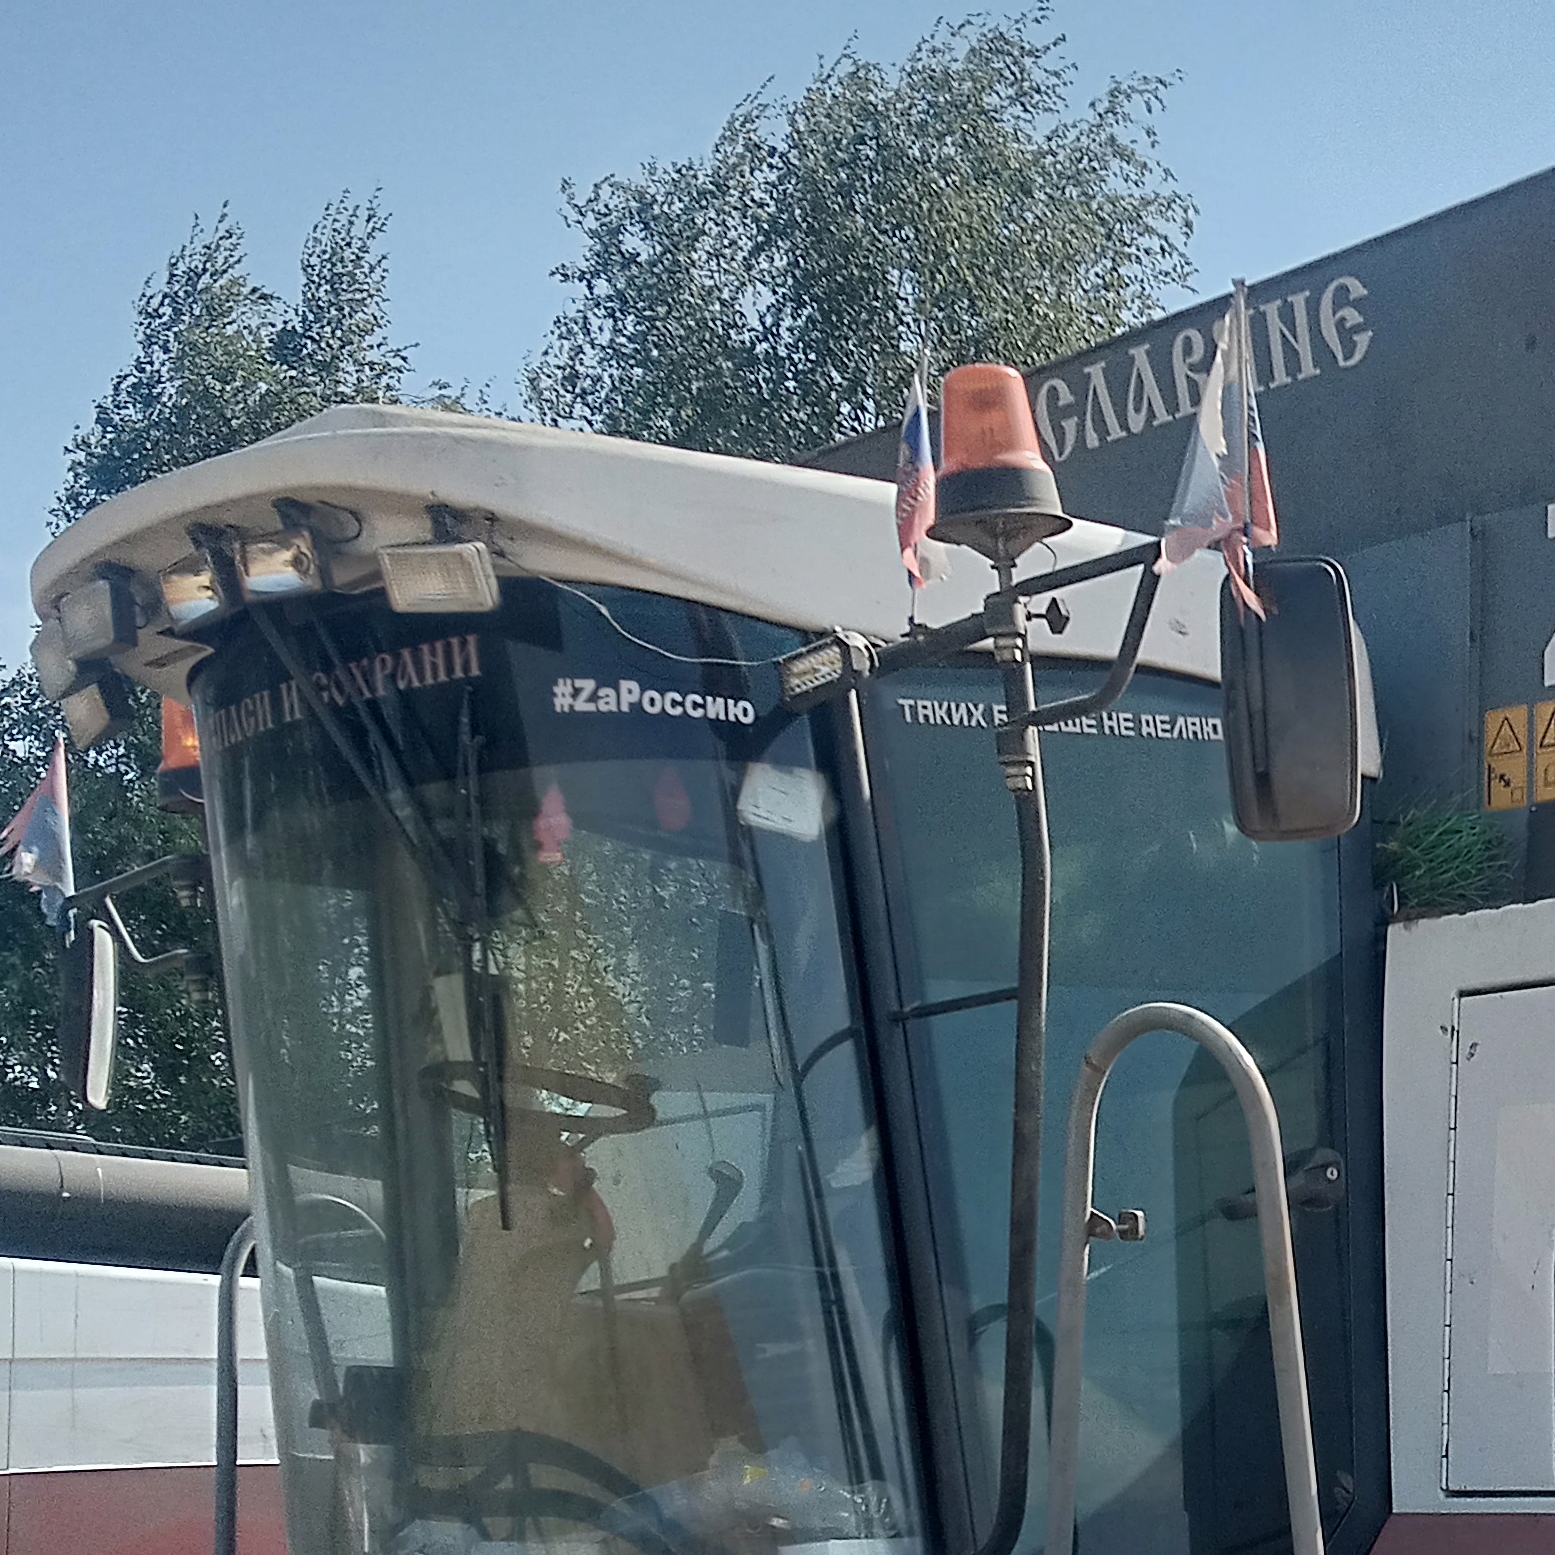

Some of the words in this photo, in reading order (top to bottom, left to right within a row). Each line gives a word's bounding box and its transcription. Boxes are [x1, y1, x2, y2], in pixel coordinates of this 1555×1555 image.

[311, 634, 482, 706] СОХРАНИ
[898, 698, 987, 728] ТАКИХ
[1102, 711, 1135, 737] НЕ
